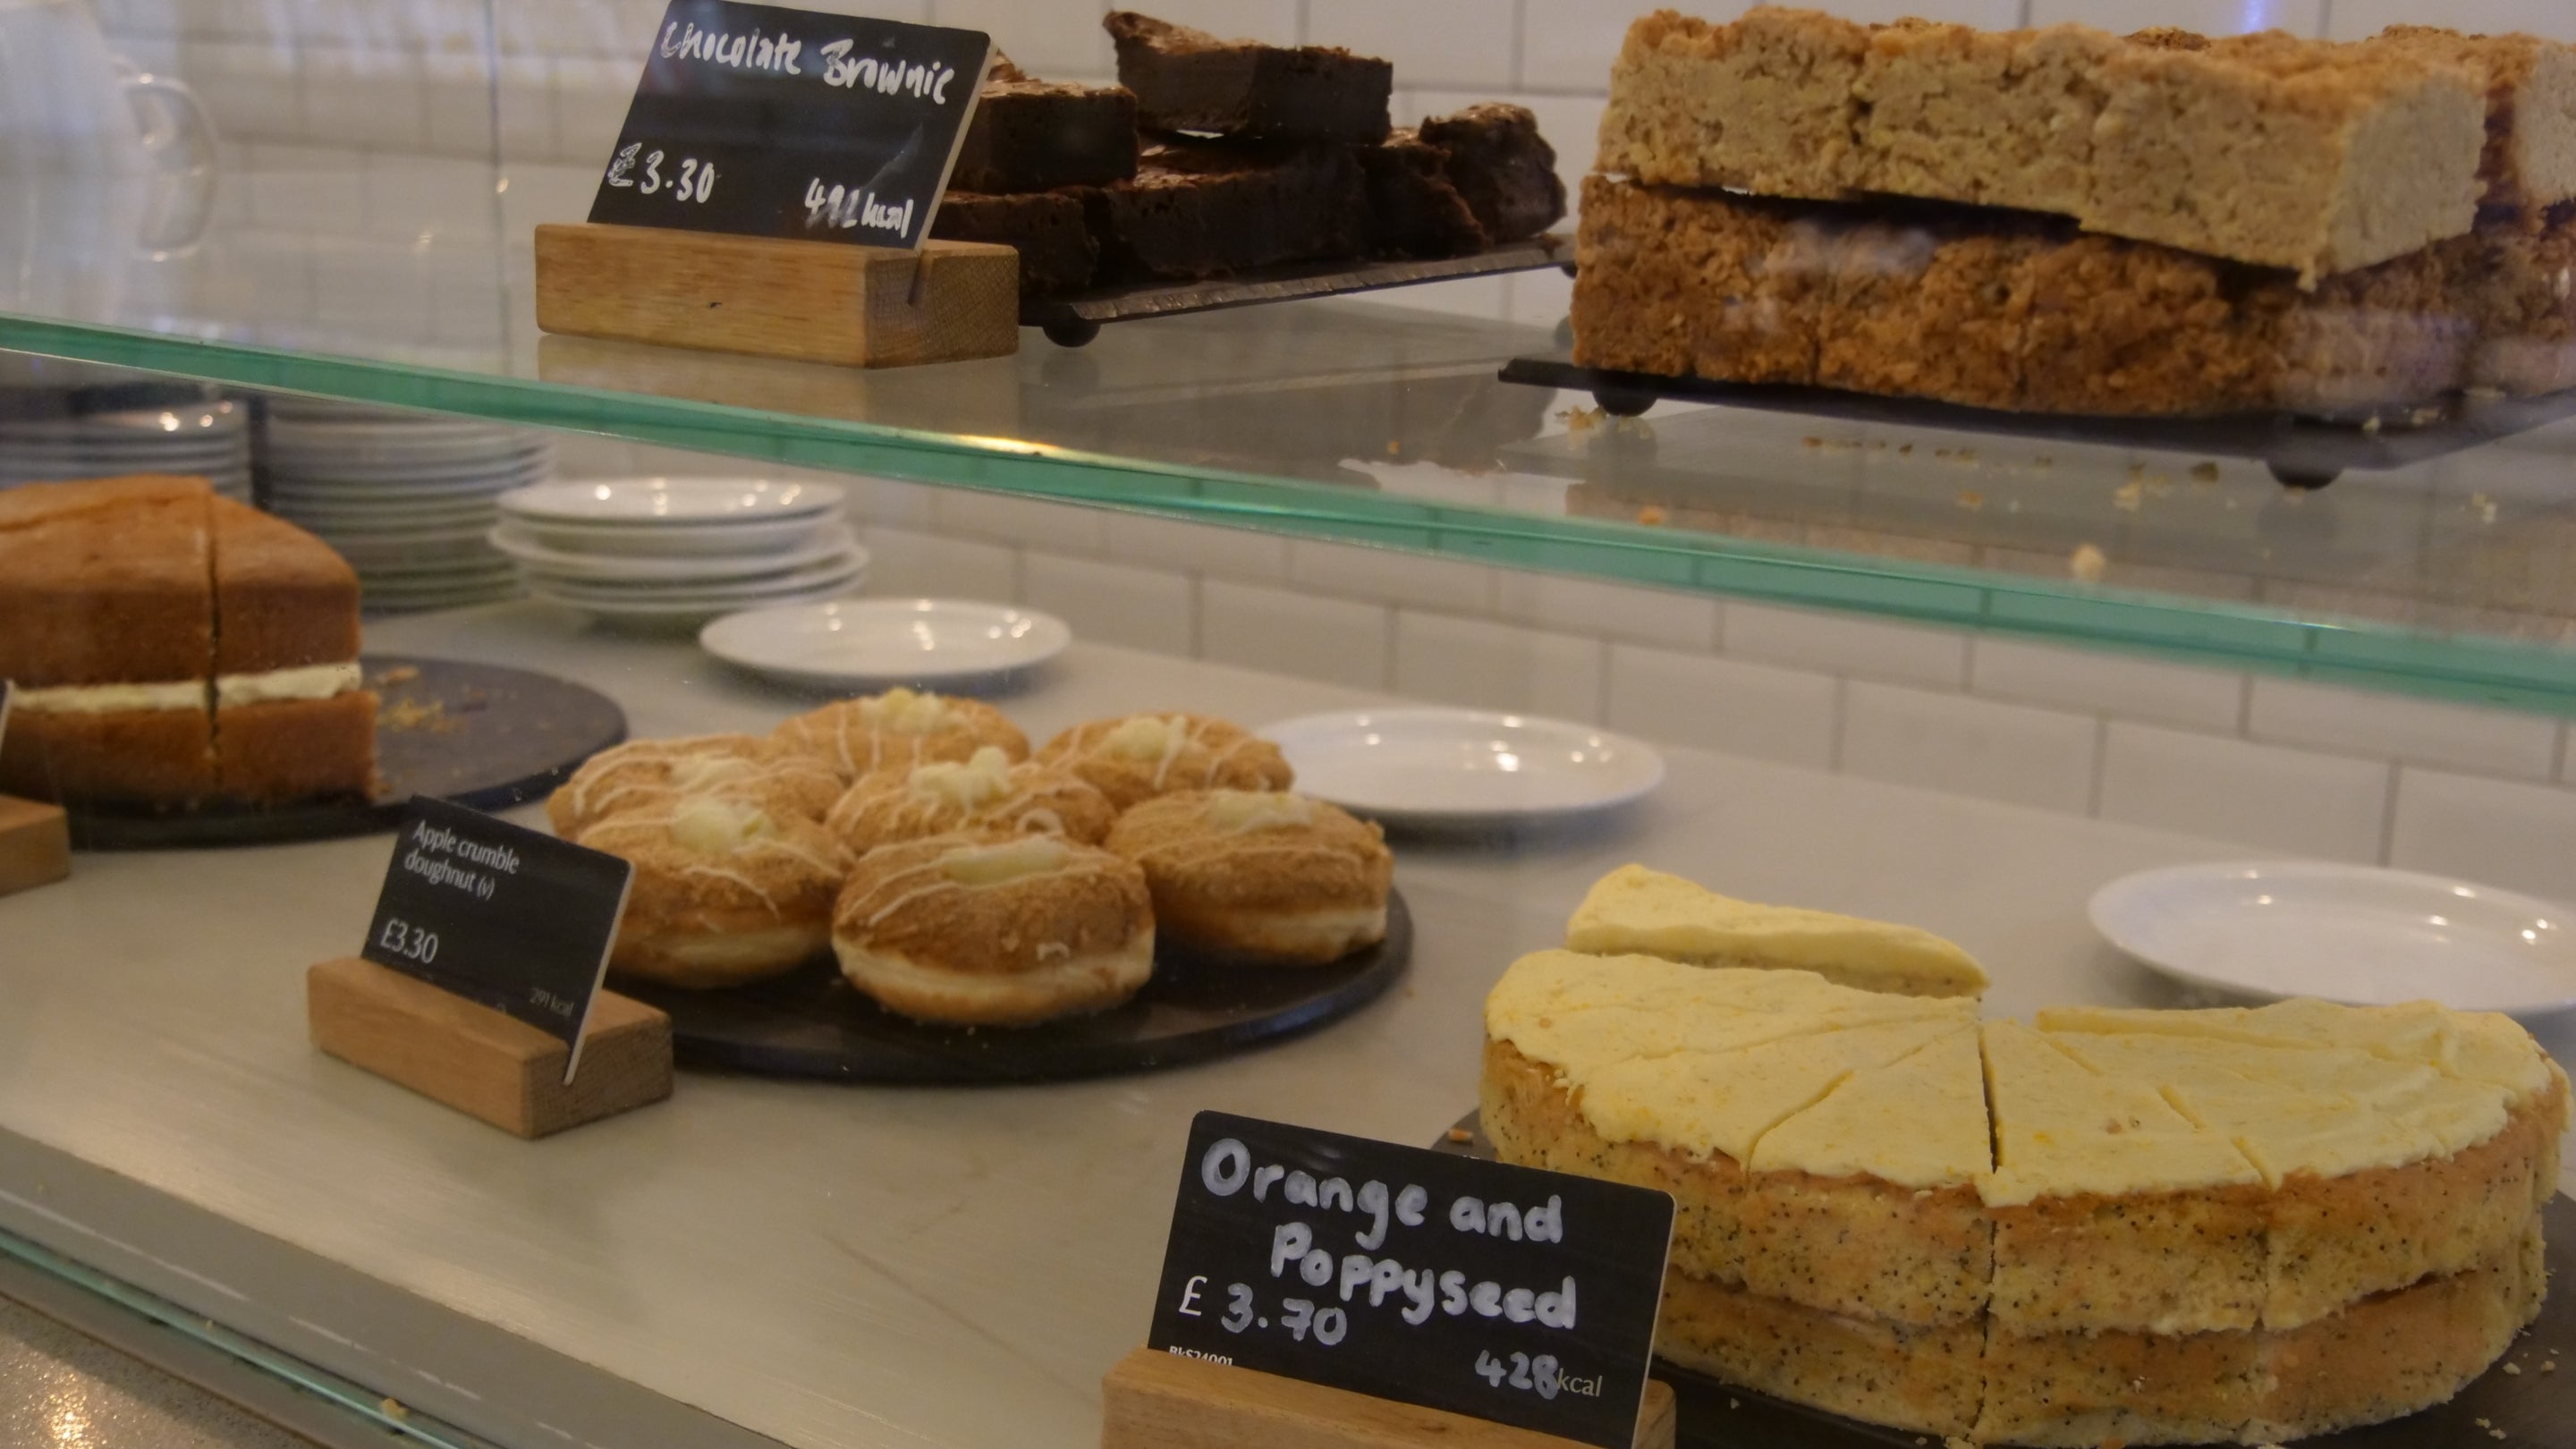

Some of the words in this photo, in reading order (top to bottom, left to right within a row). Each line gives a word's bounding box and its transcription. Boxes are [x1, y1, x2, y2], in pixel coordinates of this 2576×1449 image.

[661, 21, 801, 75] Chocolate
[821, 38, 955, 105] Brownie
[404, 848, 476, 893] doughnut
[477, 876, 496, 901] (v)
[412, 818, 457, 853] Apple
[457, 840, 520, 875] crumble
[379, 918, 438, 964] £3.30
[1201, 1138, 1428, 1250] Orange
[1450, 1193, 1562, 1243] and
[1270, 1221, 1577, 1330] Poppyseed
